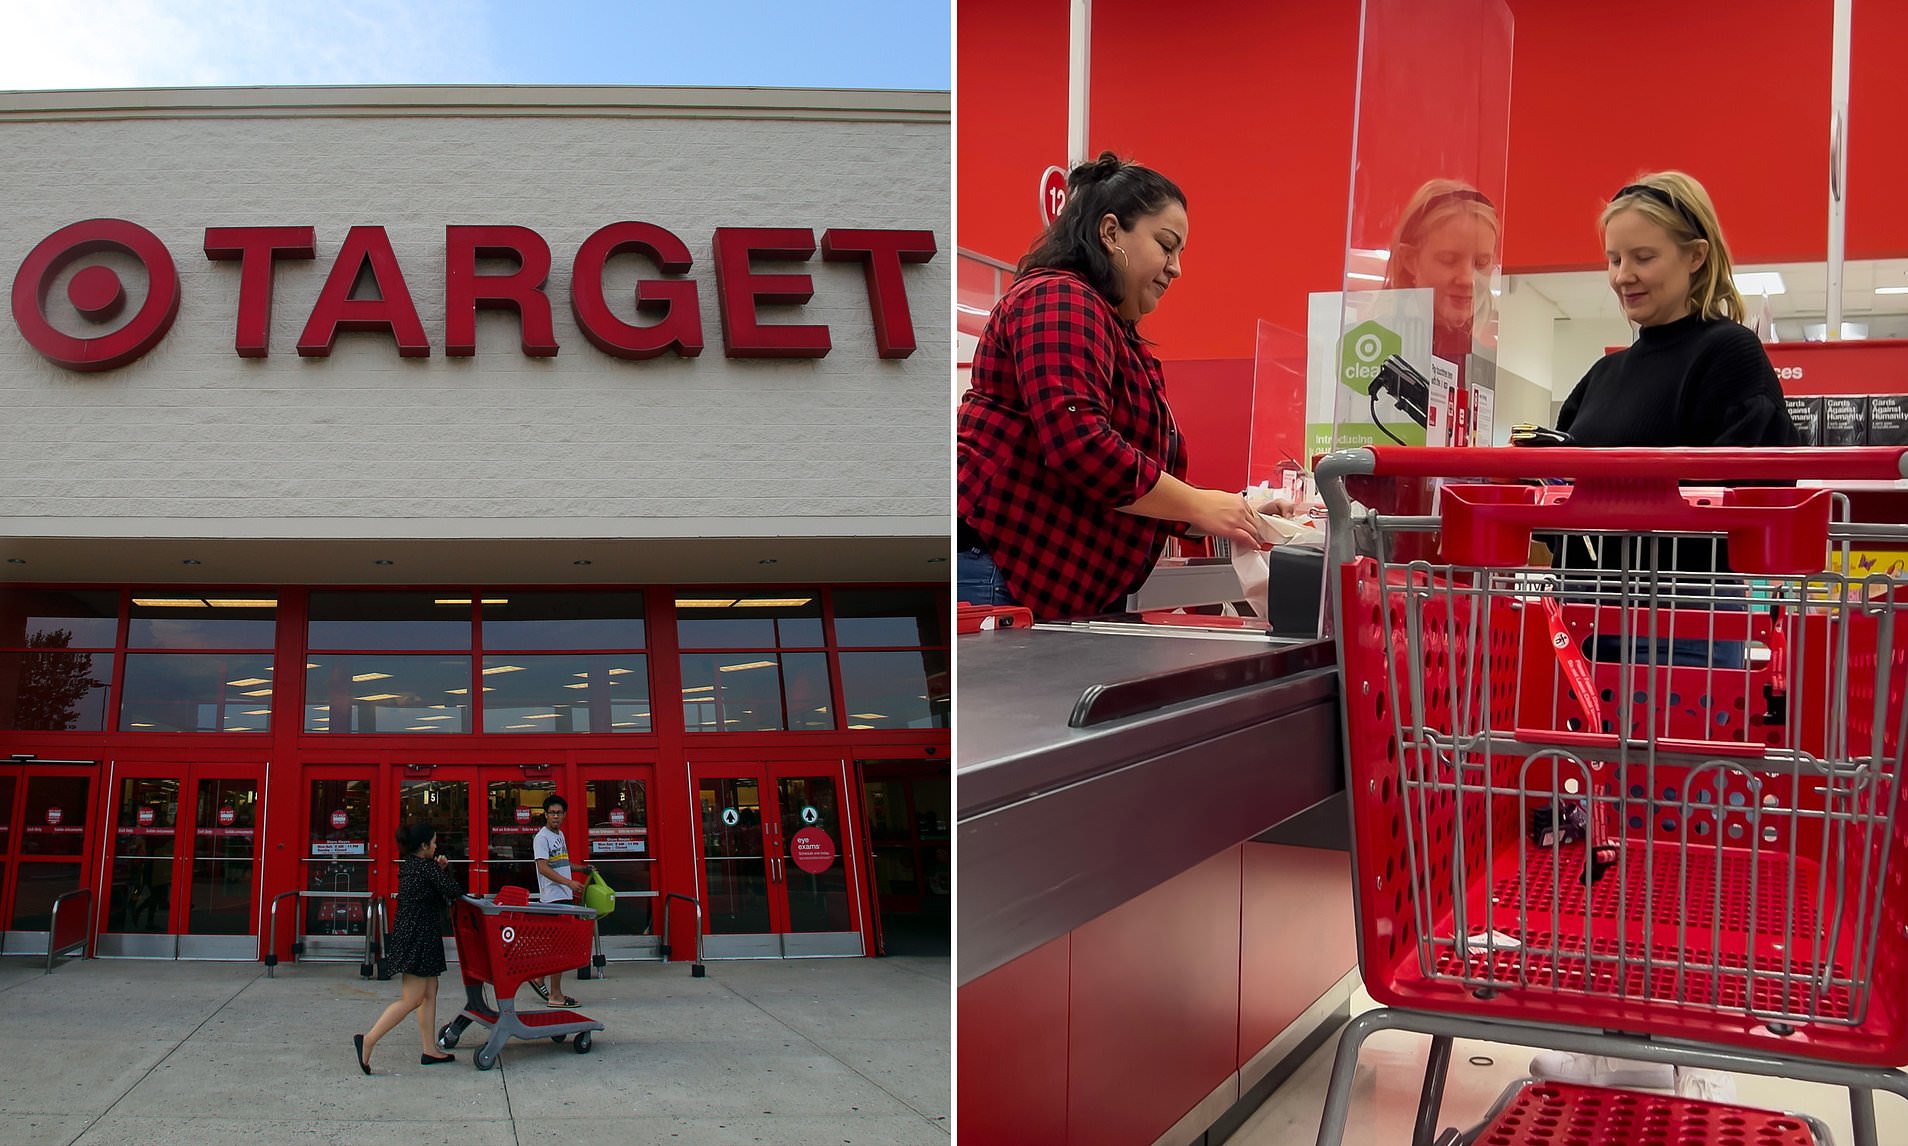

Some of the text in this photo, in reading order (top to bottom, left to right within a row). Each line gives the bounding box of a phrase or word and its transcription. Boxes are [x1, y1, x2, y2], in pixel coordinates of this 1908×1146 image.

[1049, 186, 1066, 217] 12
[204, 221, 938, 360] TARGET
[1345, 362, 1381, 379] clea
[1827, 399, 1850, 407] Cards
[1872, 399, 1895, 407] Cards
[1828, 406, 1856, 414] Against
[1872, 406, 1900, 414] Against
[1315, 434, 1373, 446] Intrducing
[430, 793, 436, 802] 5
[797, 837, 809, 845] eye
